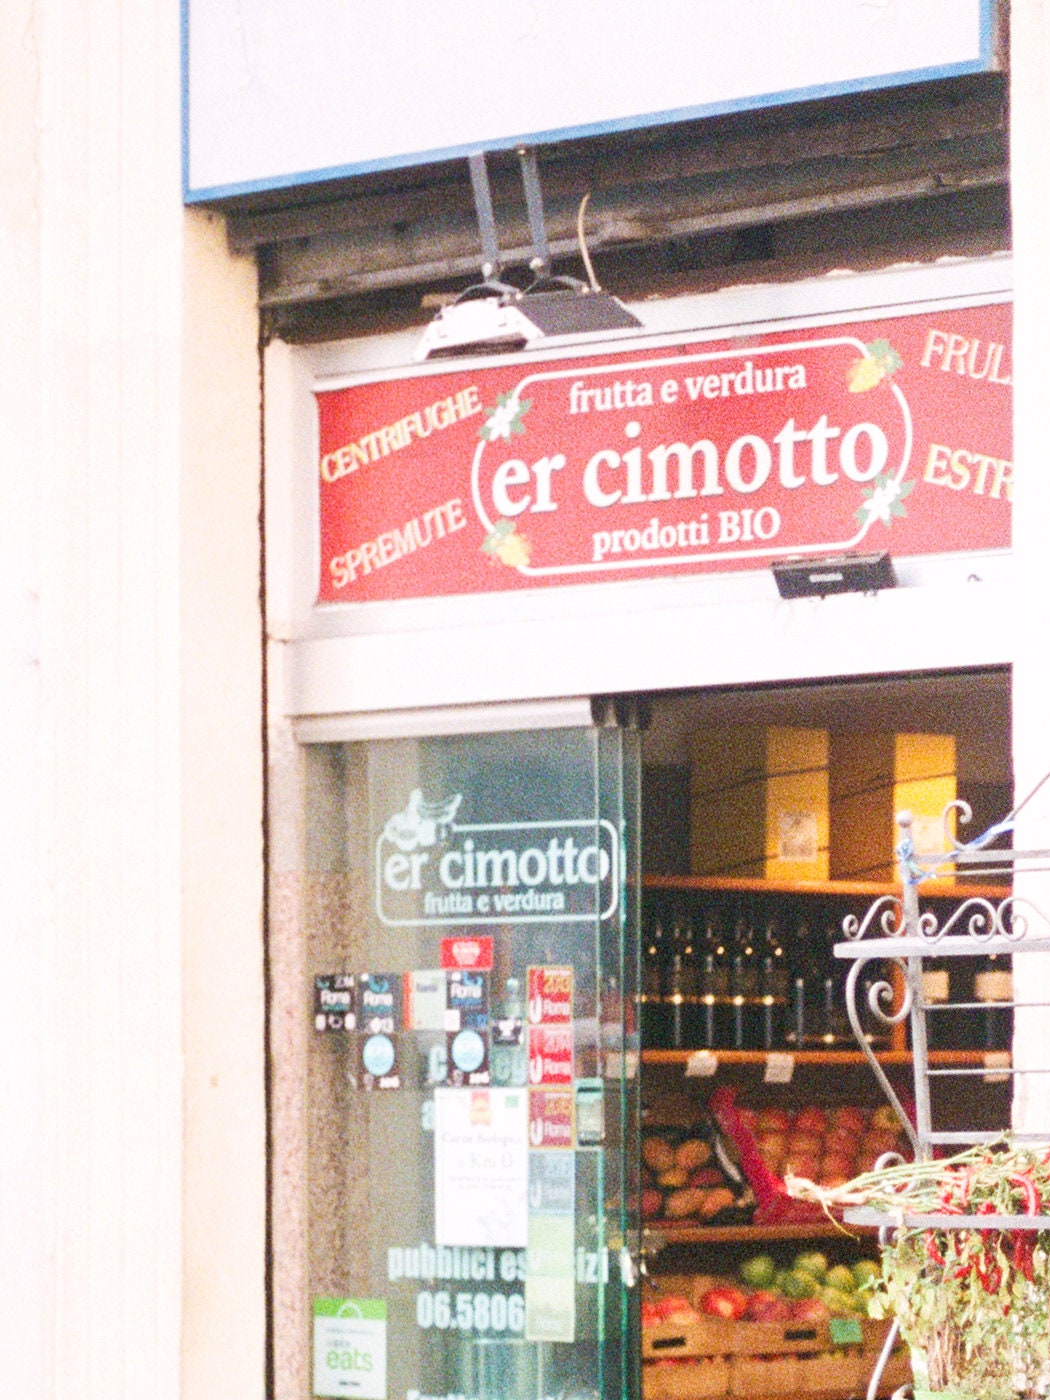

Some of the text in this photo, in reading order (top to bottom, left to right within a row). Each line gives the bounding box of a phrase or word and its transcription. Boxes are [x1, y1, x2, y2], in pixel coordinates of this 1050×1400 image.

[569, 361, 807, 416] frutta e verdura
[320, 384, 483, 484] CENTRIFUGHE
[491, 413, 889, 519] er cimotto
[329, 498, 467, 589] SPREMUTE
[592, 506, 781, 560] prodotti BIO
[384, 838, 610, 891] er cimotto
[424, 890, 565, 914] frutta e verdura
[388, 1244, 609, 1284] pubblici esizi
[326, 1347, 373, 1372] eats
